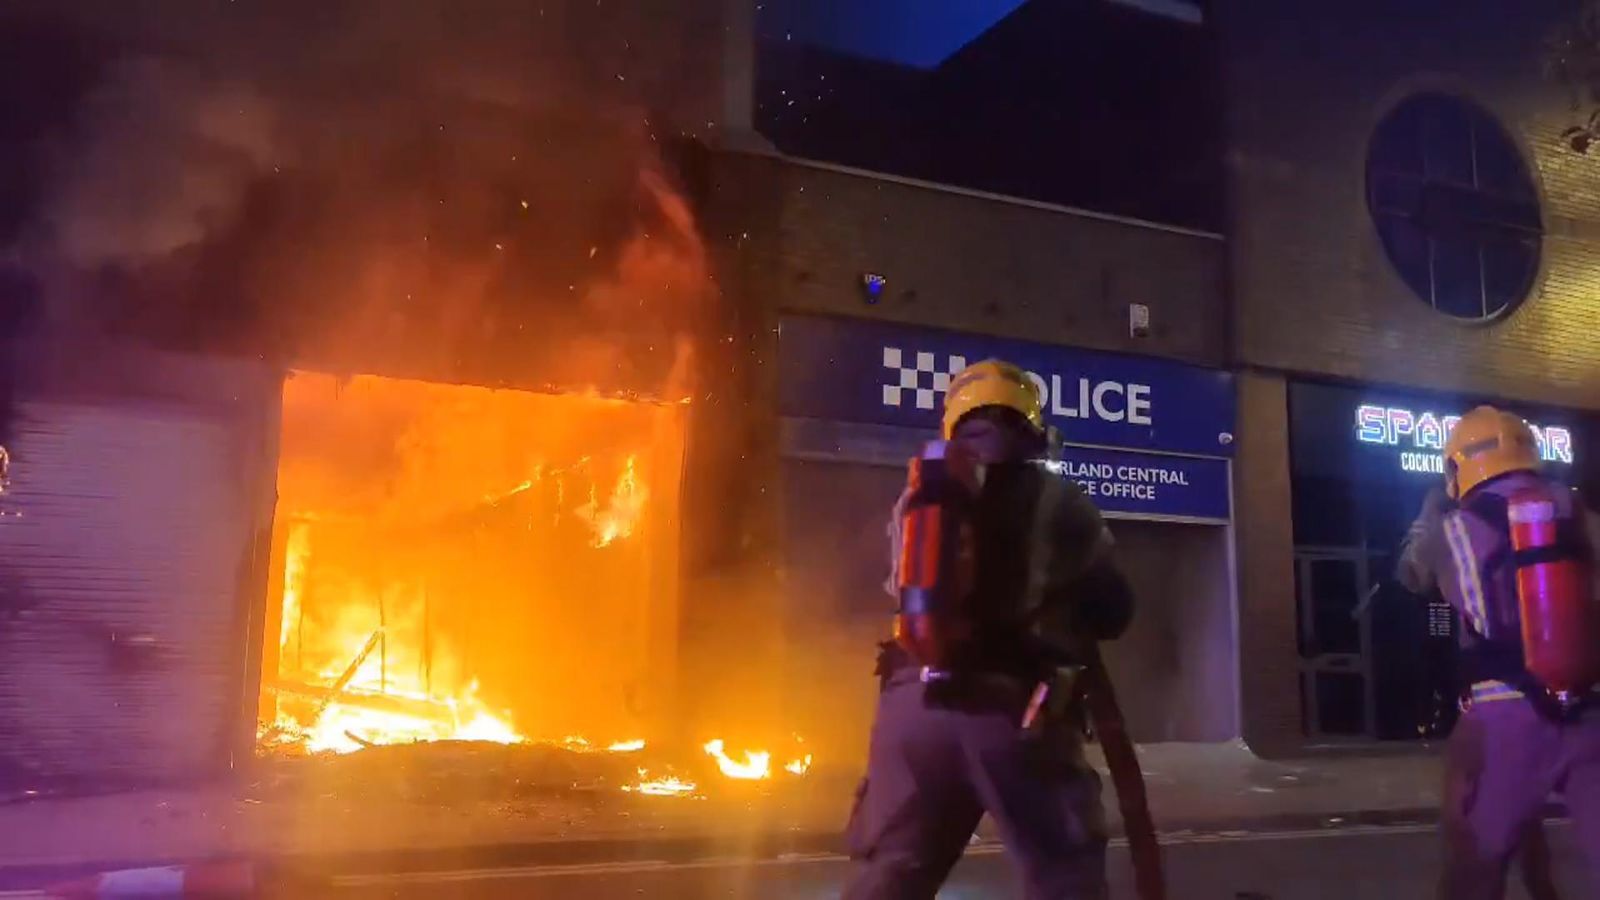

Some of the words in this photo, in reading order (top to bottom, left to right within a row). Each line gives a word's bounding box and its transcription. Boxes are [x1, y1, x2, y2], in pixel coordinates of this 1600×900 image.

[1025, 371, 1152, 425] LICE
[1357, 405, 1462, 449] SPA
[1060, 461, 1113, 479] RLAND
[1117, 466, 1188, 485] CENTRAL
[1401, 452, 1444, 473] COCKTA
[1101, 483, 1155, 499] OFFICE
